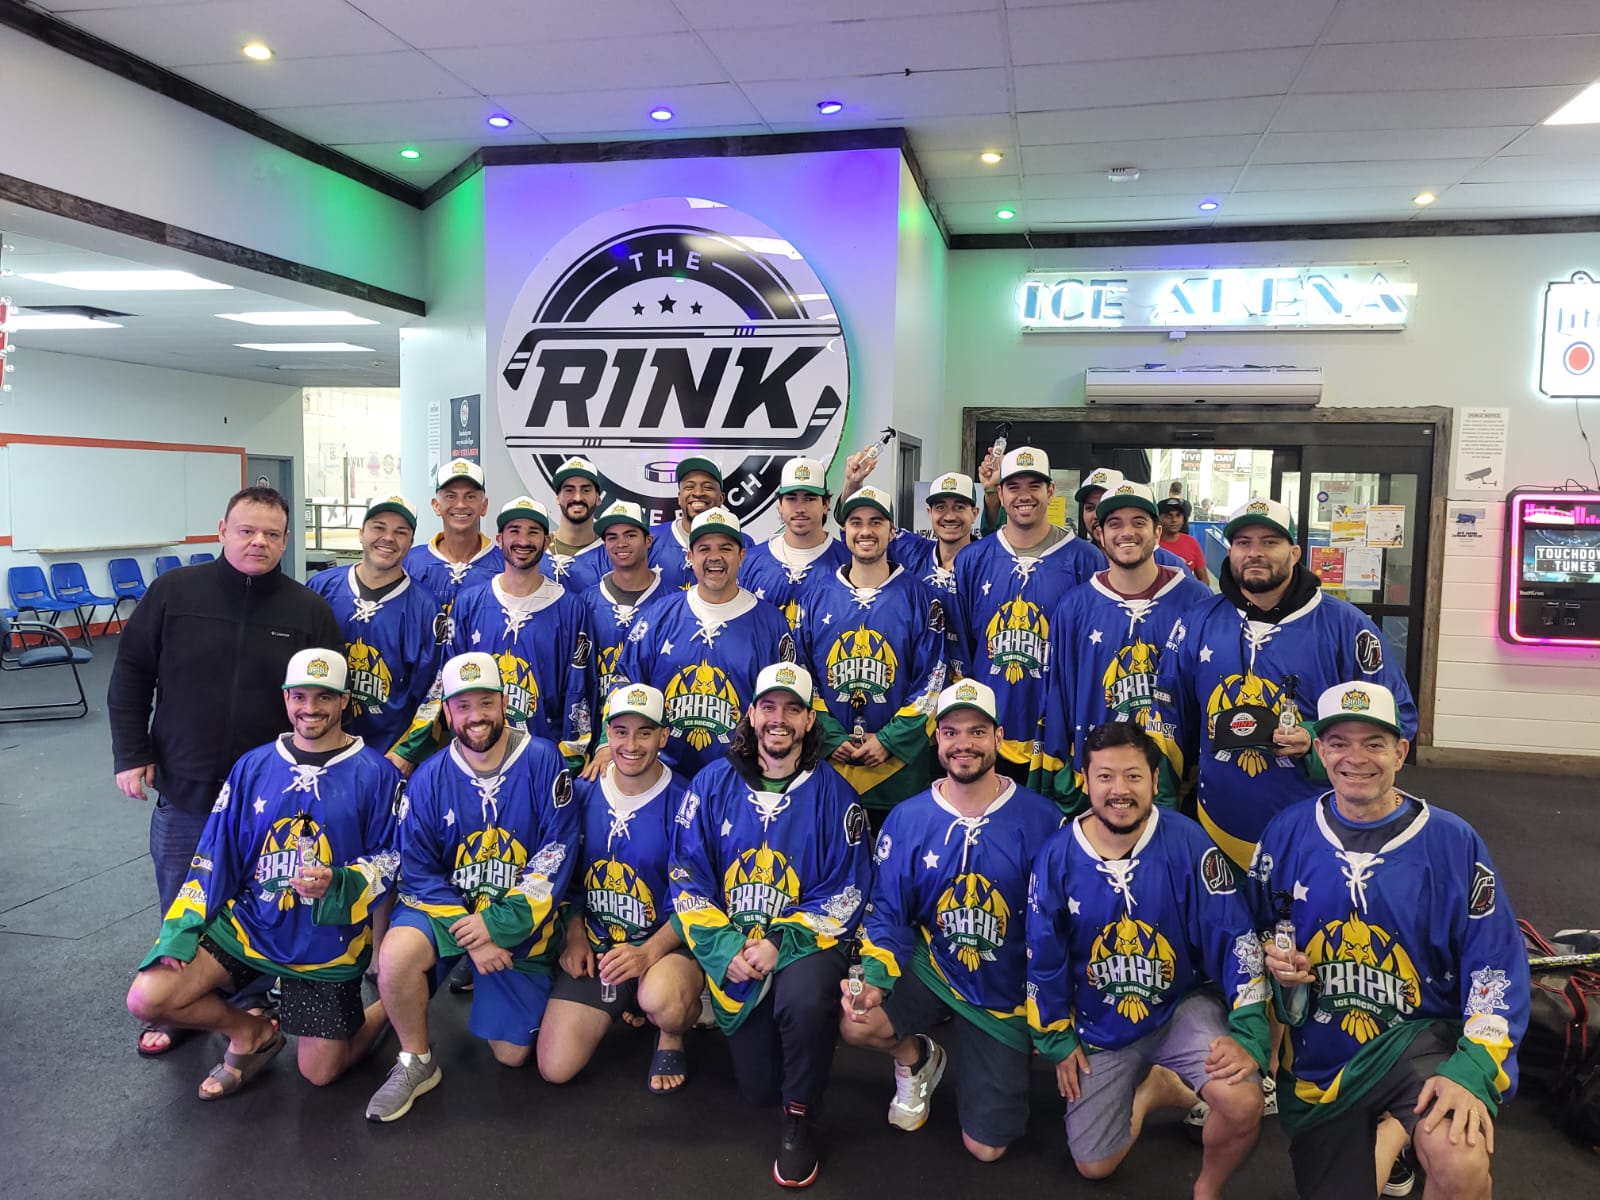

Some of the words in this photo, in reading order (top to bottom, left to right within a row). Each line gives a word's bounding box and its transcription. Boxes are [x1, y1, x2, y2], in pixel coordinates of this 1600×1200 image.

[629, 248, 702, 272] THE
[1022, 278, 1128, 319] ICE
[525, 346, 827, 429] RINK
[1537, 548, 1600, 561] TOUCHDOW
[1554, 560, 1596, 572] TUNES
[668, 694, 737, 730] BRAZIL
[1091, 954, 1172, 991] BRAZIL
[1333, 998, 1349, 1008] ICE
[1350, 997, 1383, 1015] HOCKEY
